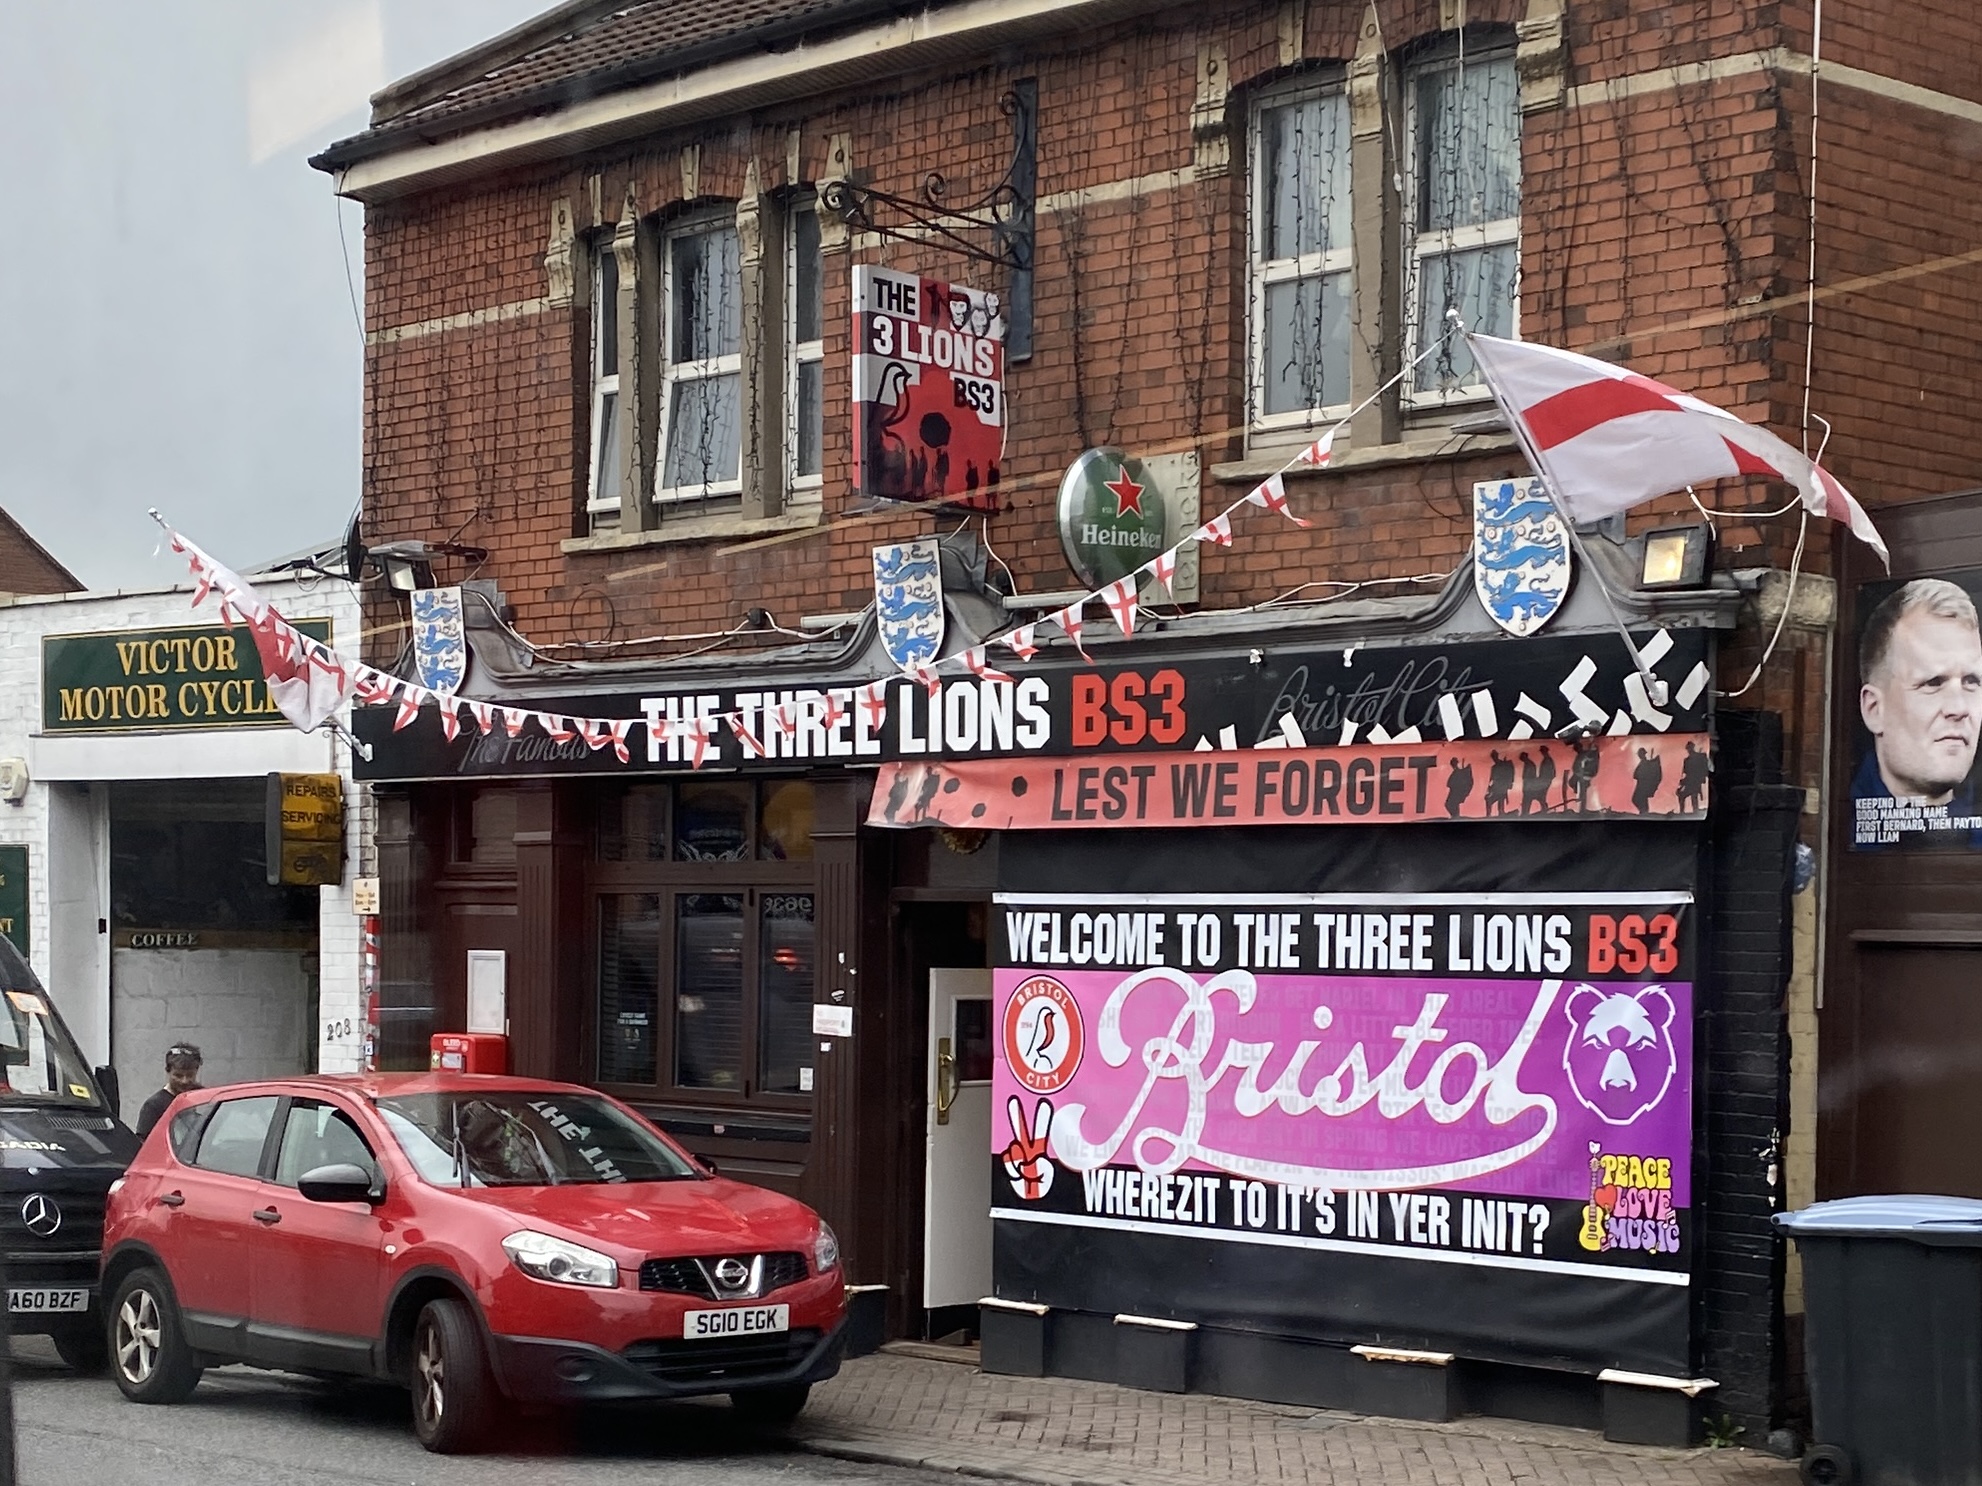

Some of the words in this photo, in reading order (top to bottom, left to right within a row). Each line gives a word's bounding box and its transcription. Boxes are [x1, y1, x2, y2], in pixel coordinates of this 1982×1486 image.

[873, 277, 916, 317] THE
[872, 315, 894, 356] 3
[902, 321, 994, 378] LIONS
[953, 377, 995, 415] BS3
[1081, 524, 1161, 549] Heineken
[116, 635, 238, 676] VICTOR
[59, 683, 170, 722] MOTOR
[640, 694, 720, 762] THE
[735, 686, 882, 760] THREE
[899, 677, 1051, 754] LIONS
[1072, 669, 1186, 748] BS3
[286, 784, 337, 799] REPAIRS
[1051, 764, 1156, 822] LEST
[1171, 761, 1239, 819] WE
[1255, 754, 1437, 818] FORGET
[1855, 797, 1894, 809] KEEPING
[281, 810, 342, 825] SERVICING
[1856, 820, 1882, 832] FIRST
[1883, 818, 1927, 833] BERNARD,
[1928, 817, 1951, 830] THEN
[1954, 816, 1982, 829] PAYTO
[1880, 807, 1922, 820] MANNING
[1923, 806, 1948, 818] NAME
[1855, 831, 1877, 844] NOW
[1877, 831, 1900, 843] LIAM
[131, 932, 198, 947] COFFEE
[1006, 911, 1166, 965] WELCOME
[1177, 912, 1221, 967] TO
[1233, 913, 1301, 968] THE
[1313, 913, 1434, 971] THREE
[1448, 914, 1572, 973] LIONS
[1587, 913, 1679, 974] BS3
[1016, 982, 1070, 1010] BRISTOL
[326, 1017, 352, 1042] 208
[1026, 1072, 1060, 1088] CITY
[1050, 966, 1564, 1193] Bristol
[1600, 1154, 1673, 1190] PEACE
[1082, 1168, 1221, 1224] WHEREZIT
[1230, 1179, 1267, 1229] TO
[1277, 1183, 1336, 1235] IT'S
[1347, 1188, 1379, 1239] IN
[1389, 1192, 1450, 1246] YER
[1461, 1197, 1551, 1255] INIT?
[1613, 1186, 1672, 1221] LOVE
[1607, 1217, 1681, 1254] MUSIC
[8, 1291, 45, 1309] A60
[49, 1291, 82, 1309] BZF
[697, 1311, 739, 1335] SG10
[743, 1308, 778, 1332] EGK
